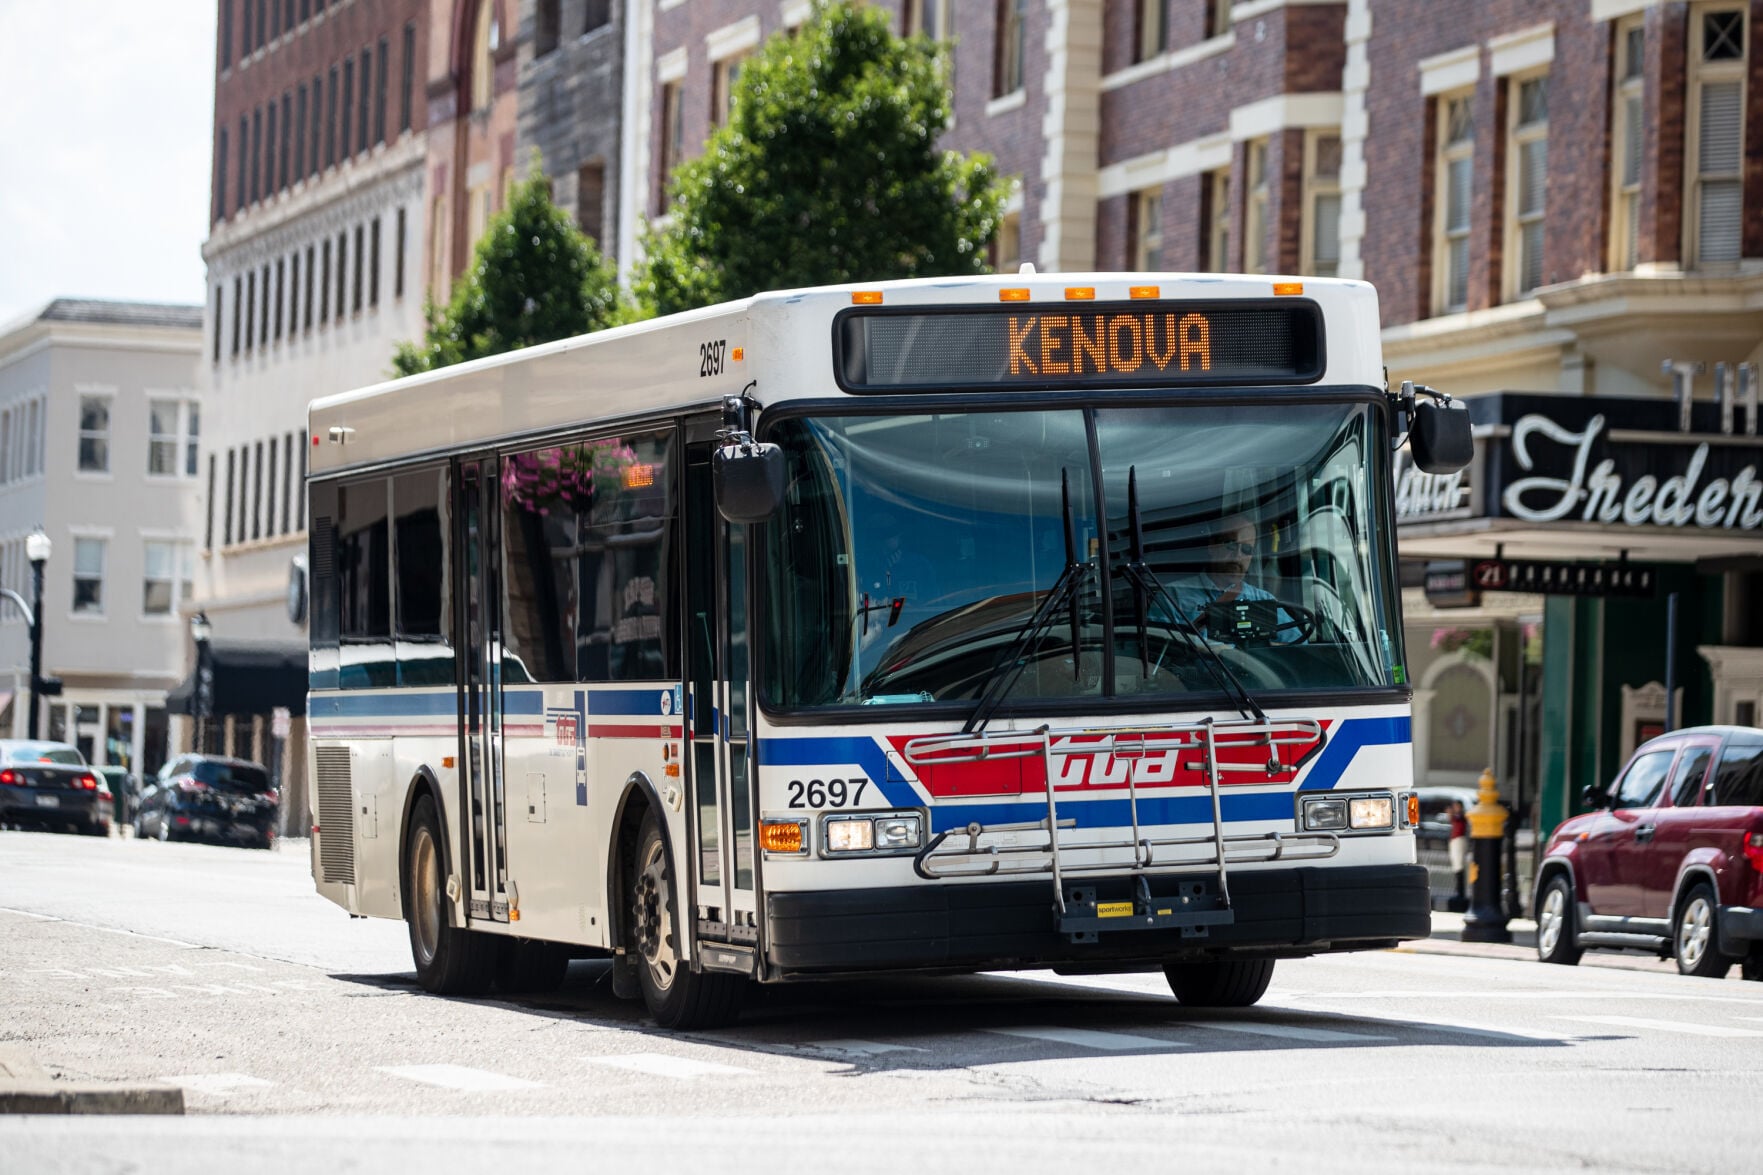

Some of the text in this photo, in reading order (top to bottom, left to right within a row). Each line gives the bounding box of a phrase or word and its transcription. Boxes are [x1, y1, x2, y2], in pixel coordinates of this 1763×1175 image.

[700, 339, 726, 377] 2697
[1009, 313, 1211, 375] KENOVA
[787, 778, 869, 809] 2697
[1098, 903, 1132, 914] sportworks
